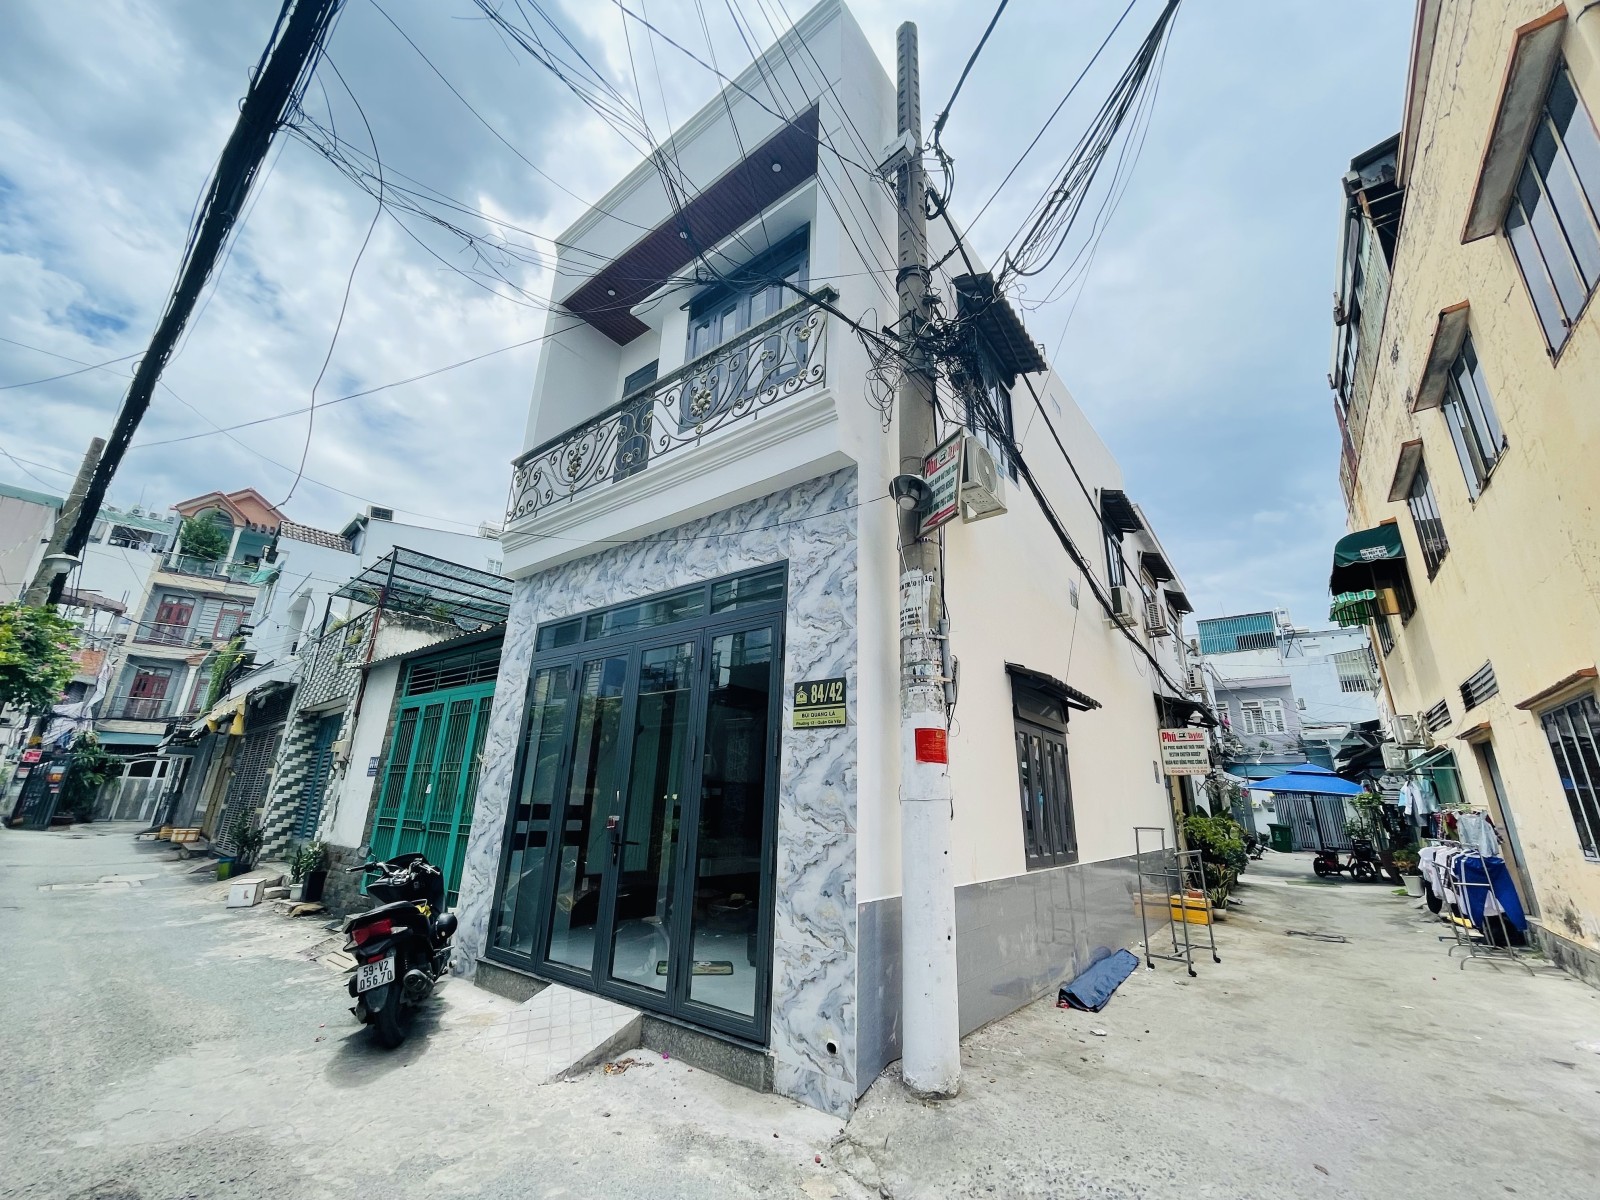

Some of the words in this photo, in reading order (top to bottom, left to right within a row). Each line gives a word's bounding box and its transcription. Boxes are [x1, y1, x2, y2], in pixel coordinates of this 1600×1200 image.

[811, 681, 843, 703] 84/42
[363, 960, 389, 978] 59-V2
[360, 970, 394, 990] 056.70
